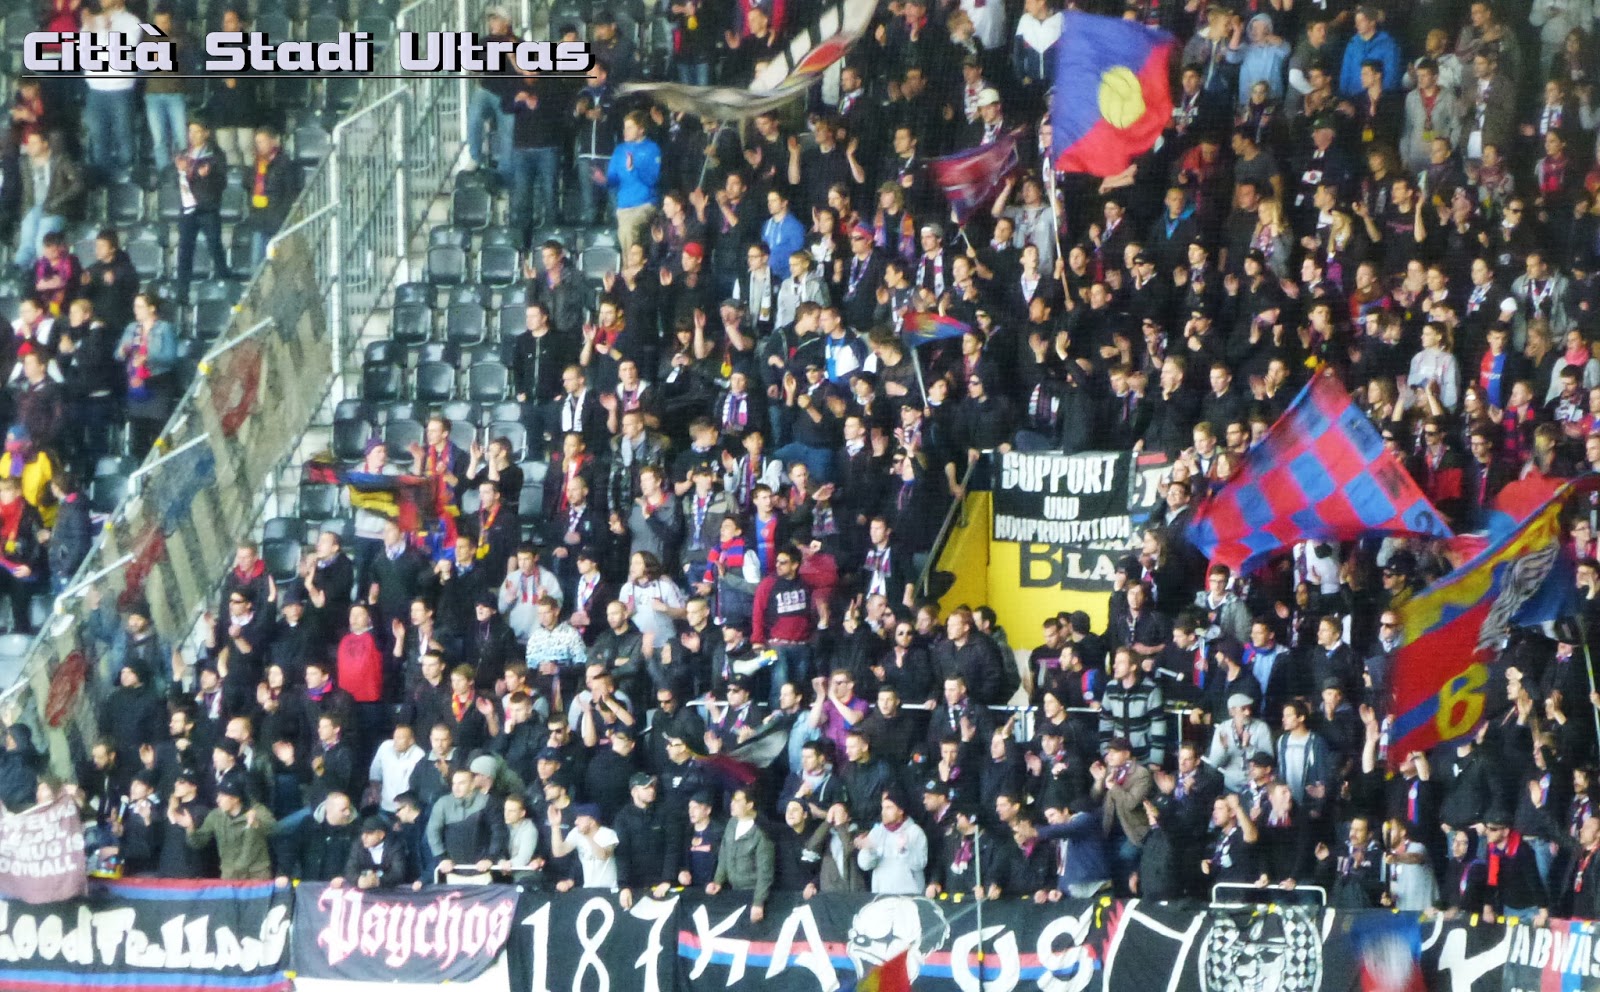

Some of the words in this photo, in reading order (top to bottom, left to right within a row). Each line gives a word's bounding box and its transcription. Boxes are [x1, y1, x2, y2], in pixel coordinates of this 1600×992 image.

[1002, 452, 1119, 494] SUPPORT
[1043, 496, 1080, 520] UND
[994, 513, 1131, 544] KONFRONTATION
[317, 887, 515, 970] Psychos
